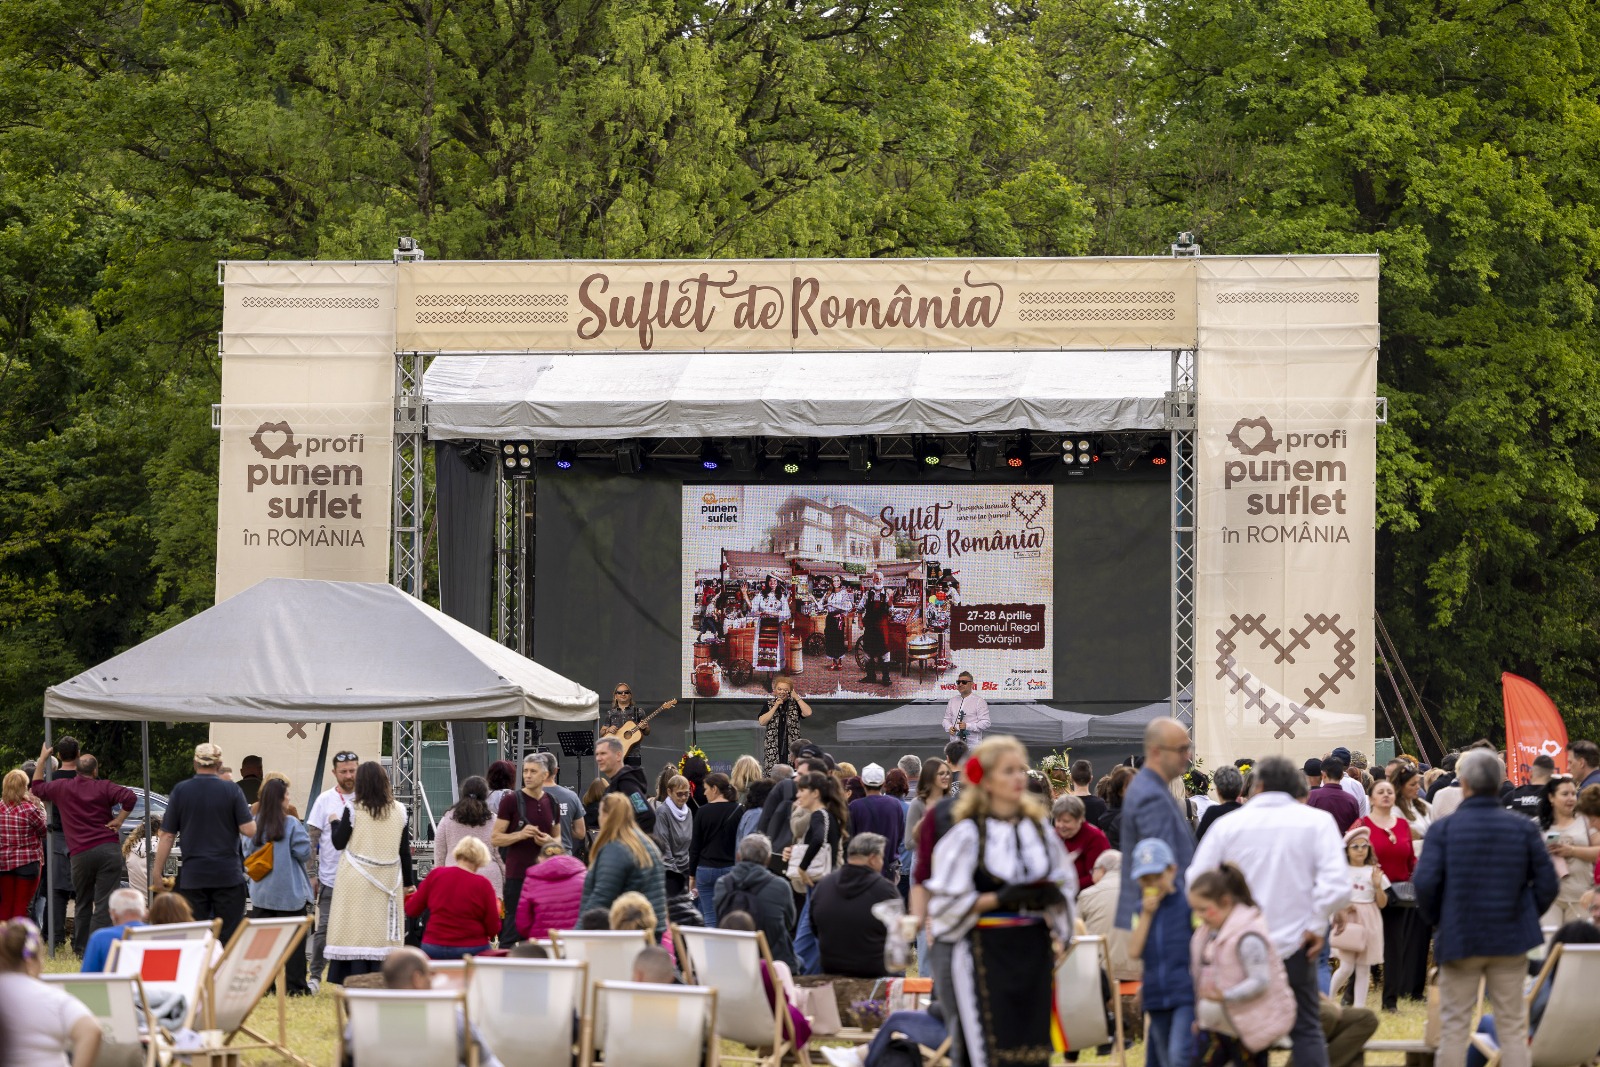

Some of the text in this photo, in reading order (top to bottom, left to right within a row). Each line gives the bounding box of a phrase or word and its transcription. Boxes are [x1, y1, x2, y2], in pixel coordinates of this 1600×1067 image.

[576, 269, 1004, 351] Suflet de România
[305, 433, 364, 458] profi
[1286, 429, 1347, 453] profi
[247, 463, 363, 493] punem
[1224, 459, 1347, 490] punem
[267, 489, 362, 519] suflet
[701, 505, 737, 514] punem
[1246, 485, 1347, 516] suflet
[708, 513, 737, 522] suflet
[880, 501, 953, 540] Suflet
[242, 524, 366, 547] în ROMÂNIA
[911, 527, 1045, 558] de România
[1221, 521, 1351, 544] în ROMÂNIA
[959, 622, 1040, 634] Domeniul Regal
[966, 610, 1032, 623] 27-28 Aprilie
[977, 634, 1022, 645] Săvârșin
[981, 681, 999, 691] Biz
